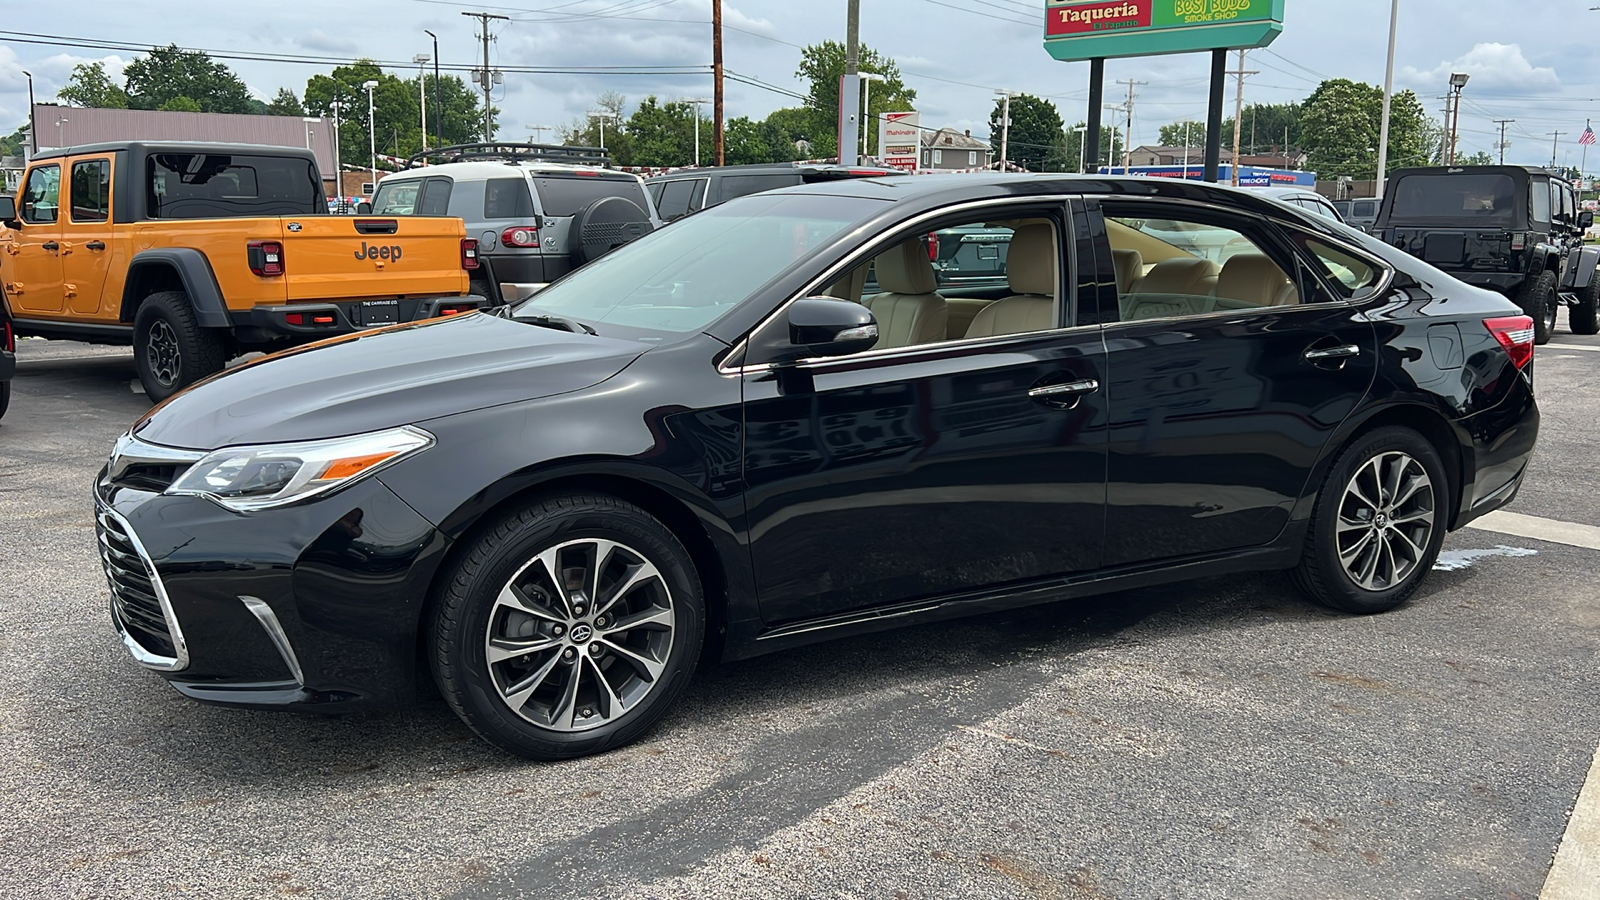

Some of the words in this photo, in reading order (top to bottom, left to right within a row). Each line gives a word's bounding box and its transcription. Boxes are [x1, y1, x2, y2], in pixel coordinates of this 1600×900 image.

[1184, 13, 1213, 23] SMOKE
[1214, 11, 1238, 20] SHOP
[354, 242, 402, 263] Jeep
